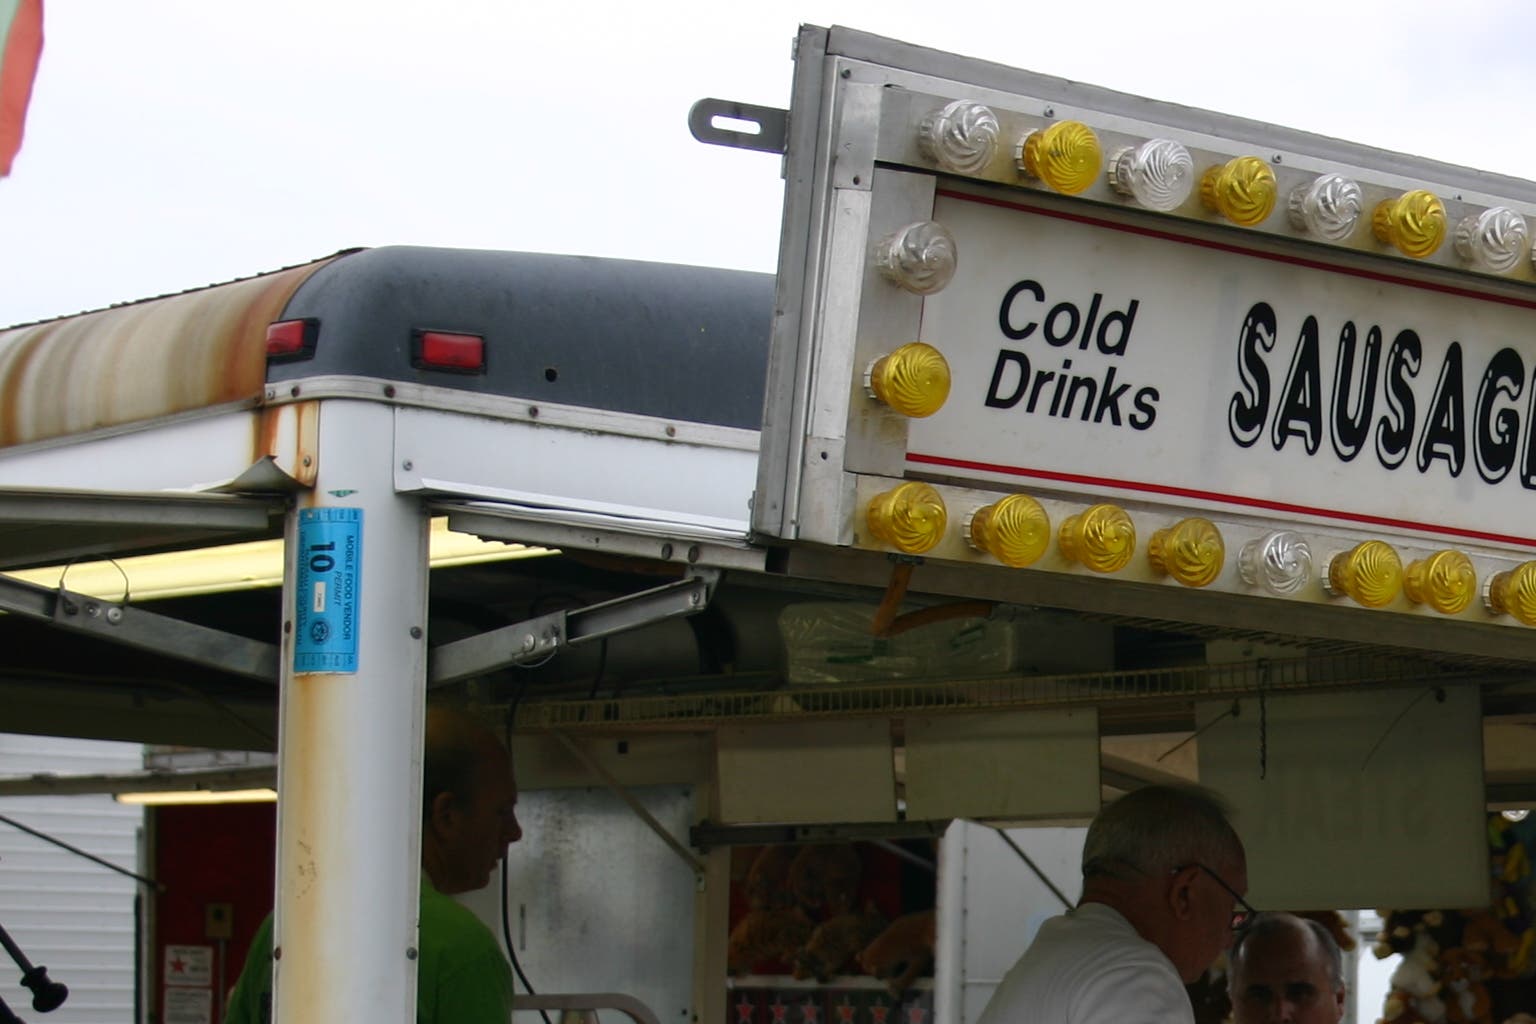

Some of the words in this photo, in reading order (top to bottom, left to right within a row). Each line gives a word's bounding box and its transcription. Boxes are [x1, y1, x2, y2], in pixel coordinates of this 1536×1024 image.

[999, 279, 1140, 357] Cold
[984, 348, 1160, 431] Drinks
[310, 541, 336, 573] 10
[344, 573, 354, 600] FOOD
[343, 602, 353, 641] VENDOR
